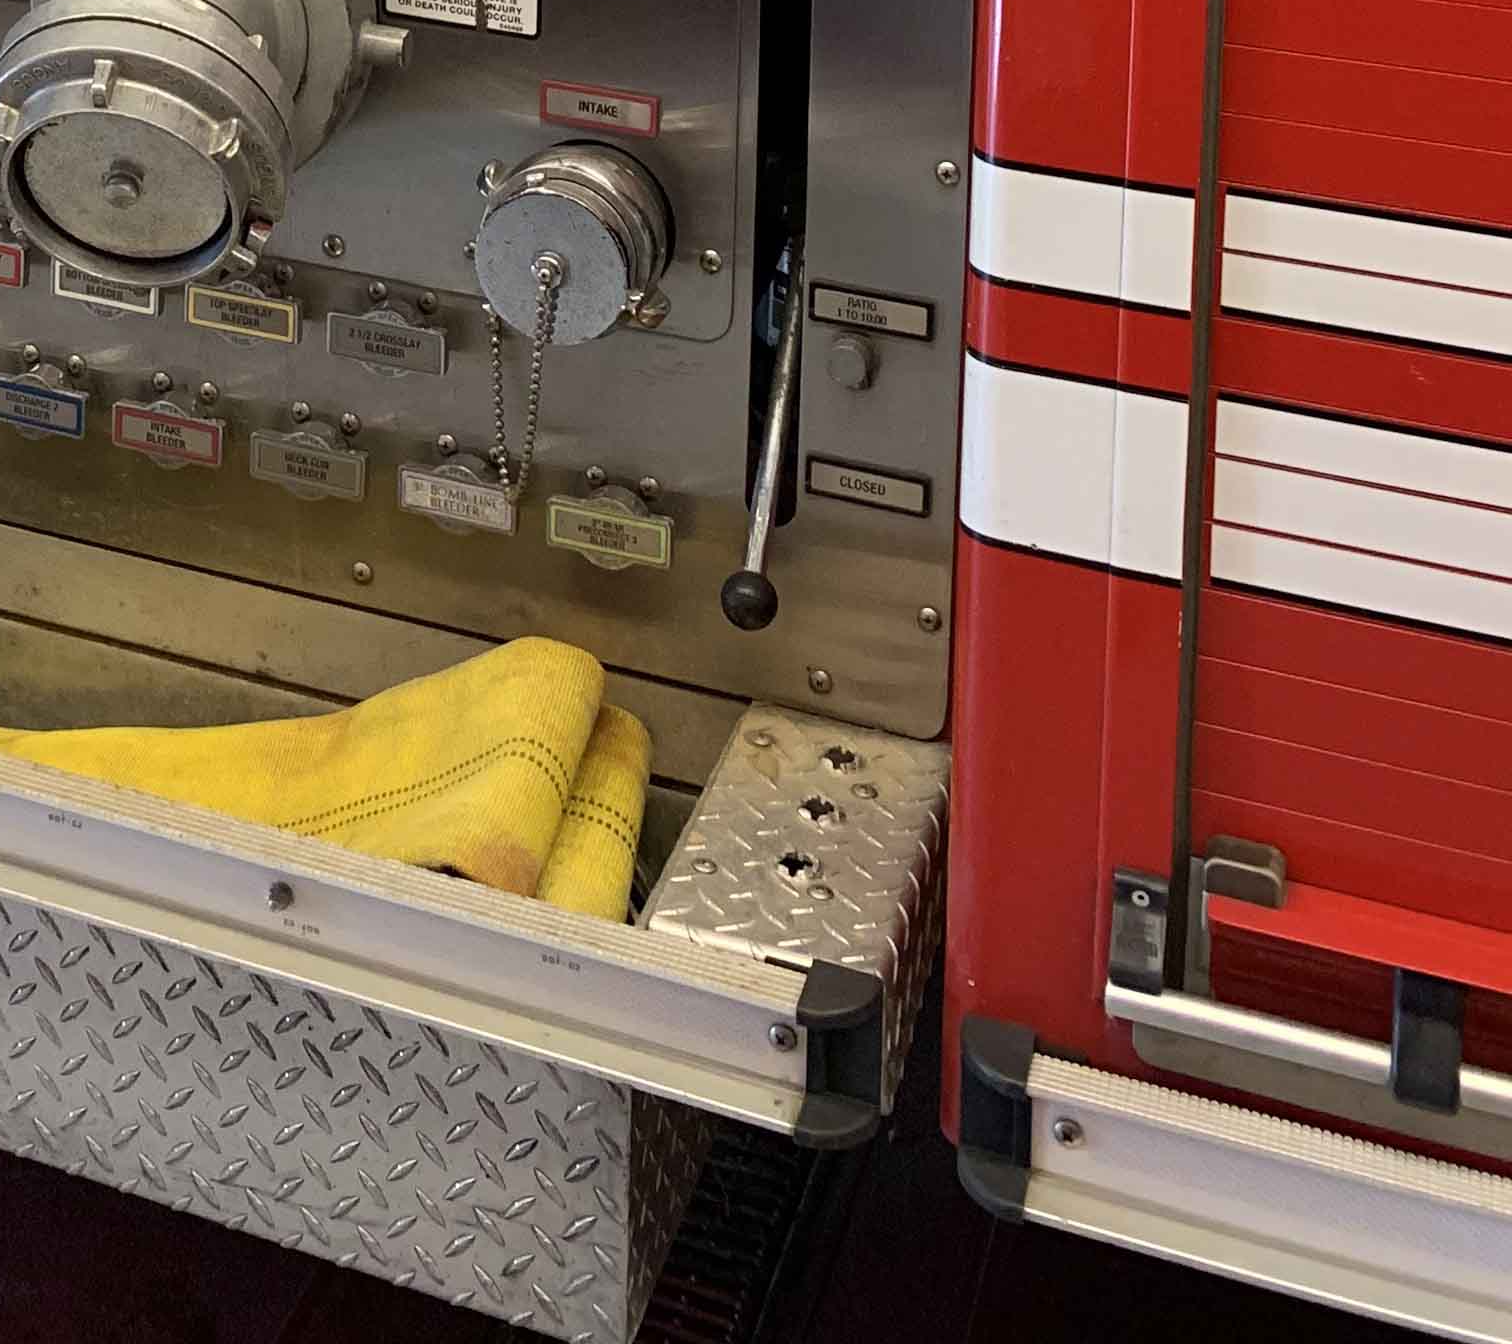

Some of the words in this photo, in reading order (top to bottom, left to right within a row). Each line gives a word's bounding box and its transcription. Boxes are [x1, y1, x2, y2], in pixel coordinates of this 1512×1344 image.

[415, 0, 446, 13] DEATH
[578, 100, 618, 117] INTAKE
[846, 310, 858, 321] TO
[373, 331, 421, 349] CROSSLAY
[365, 342, 405, 358] BLEEDER
[6, 392, 50, 408] DISCHARGE
[14, 405, 51, 421] BLEEDER
[151, 423, 182, 437] INTAKE
[146, 432, 186, 449] BLEEDER
[840, 475, 886, 495] CLOSED
